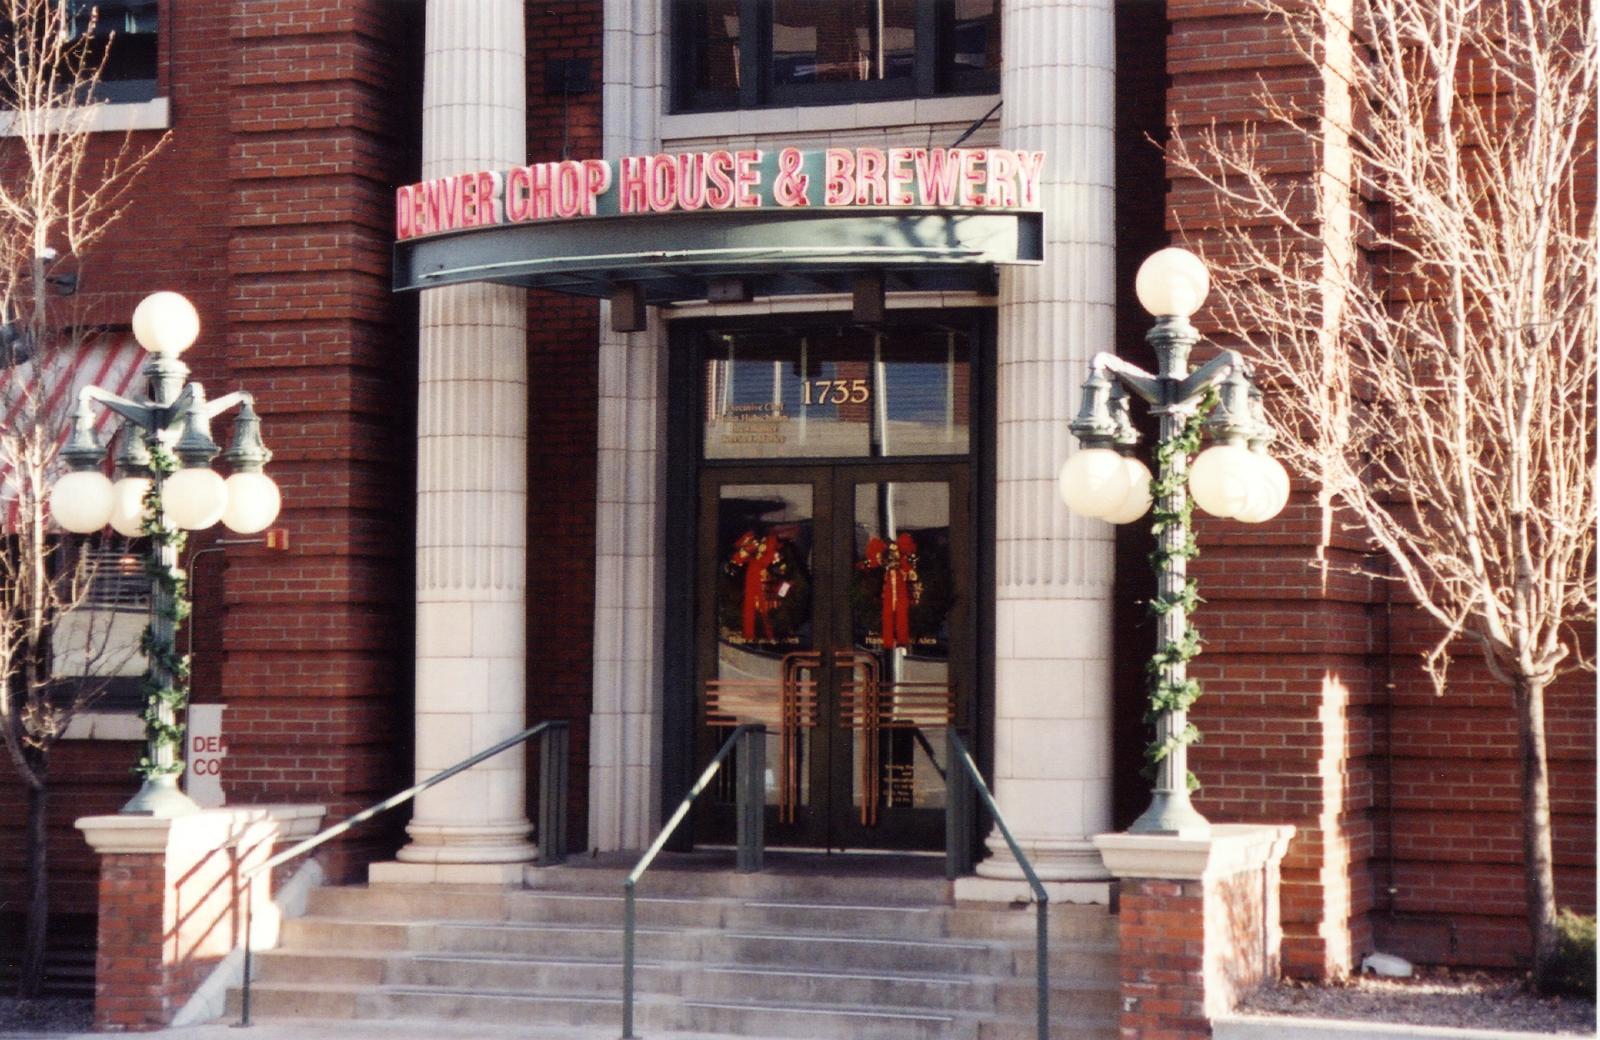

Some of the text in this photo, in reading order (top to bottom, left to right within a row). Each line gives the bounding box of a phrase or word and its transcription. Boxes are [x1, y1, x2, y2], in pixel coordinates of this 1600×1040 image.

[396, 147, 1046, 240] DENVER CHOP HOUSE & BREWERY
[803, 379, 870, 406] 1735
